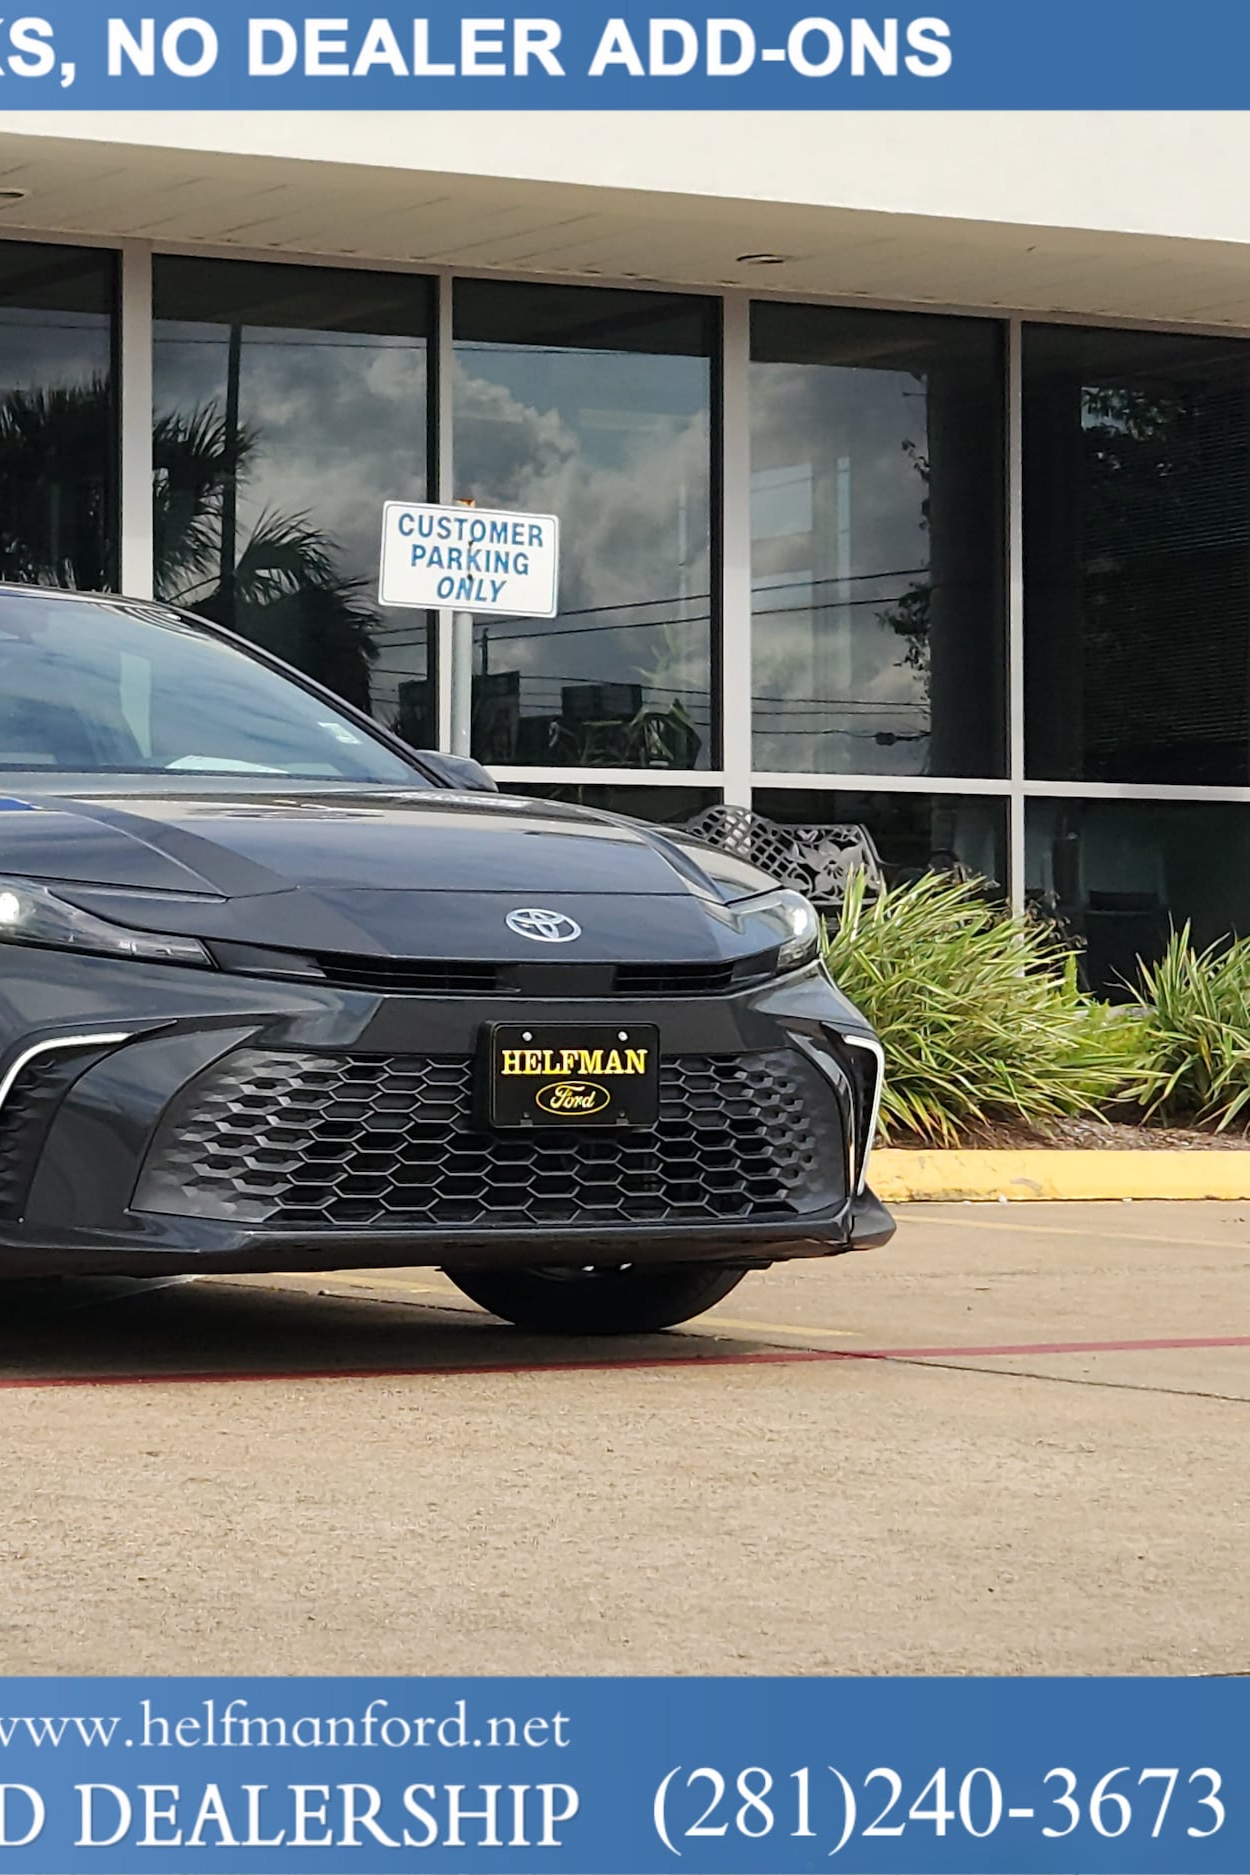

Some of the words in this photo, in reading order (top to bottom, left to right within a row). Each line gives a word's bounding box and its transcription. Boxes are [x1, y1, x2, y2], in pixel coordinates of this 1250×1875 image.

[398, 513, 543, 547] CUSTOMER
[411, 544, 529, 575] PARKING
[437, 576, 507, 602] ONLY
[501, 1049, 648, 1075] HELFMAN
[550, 1084, 596, 1108] Ford
